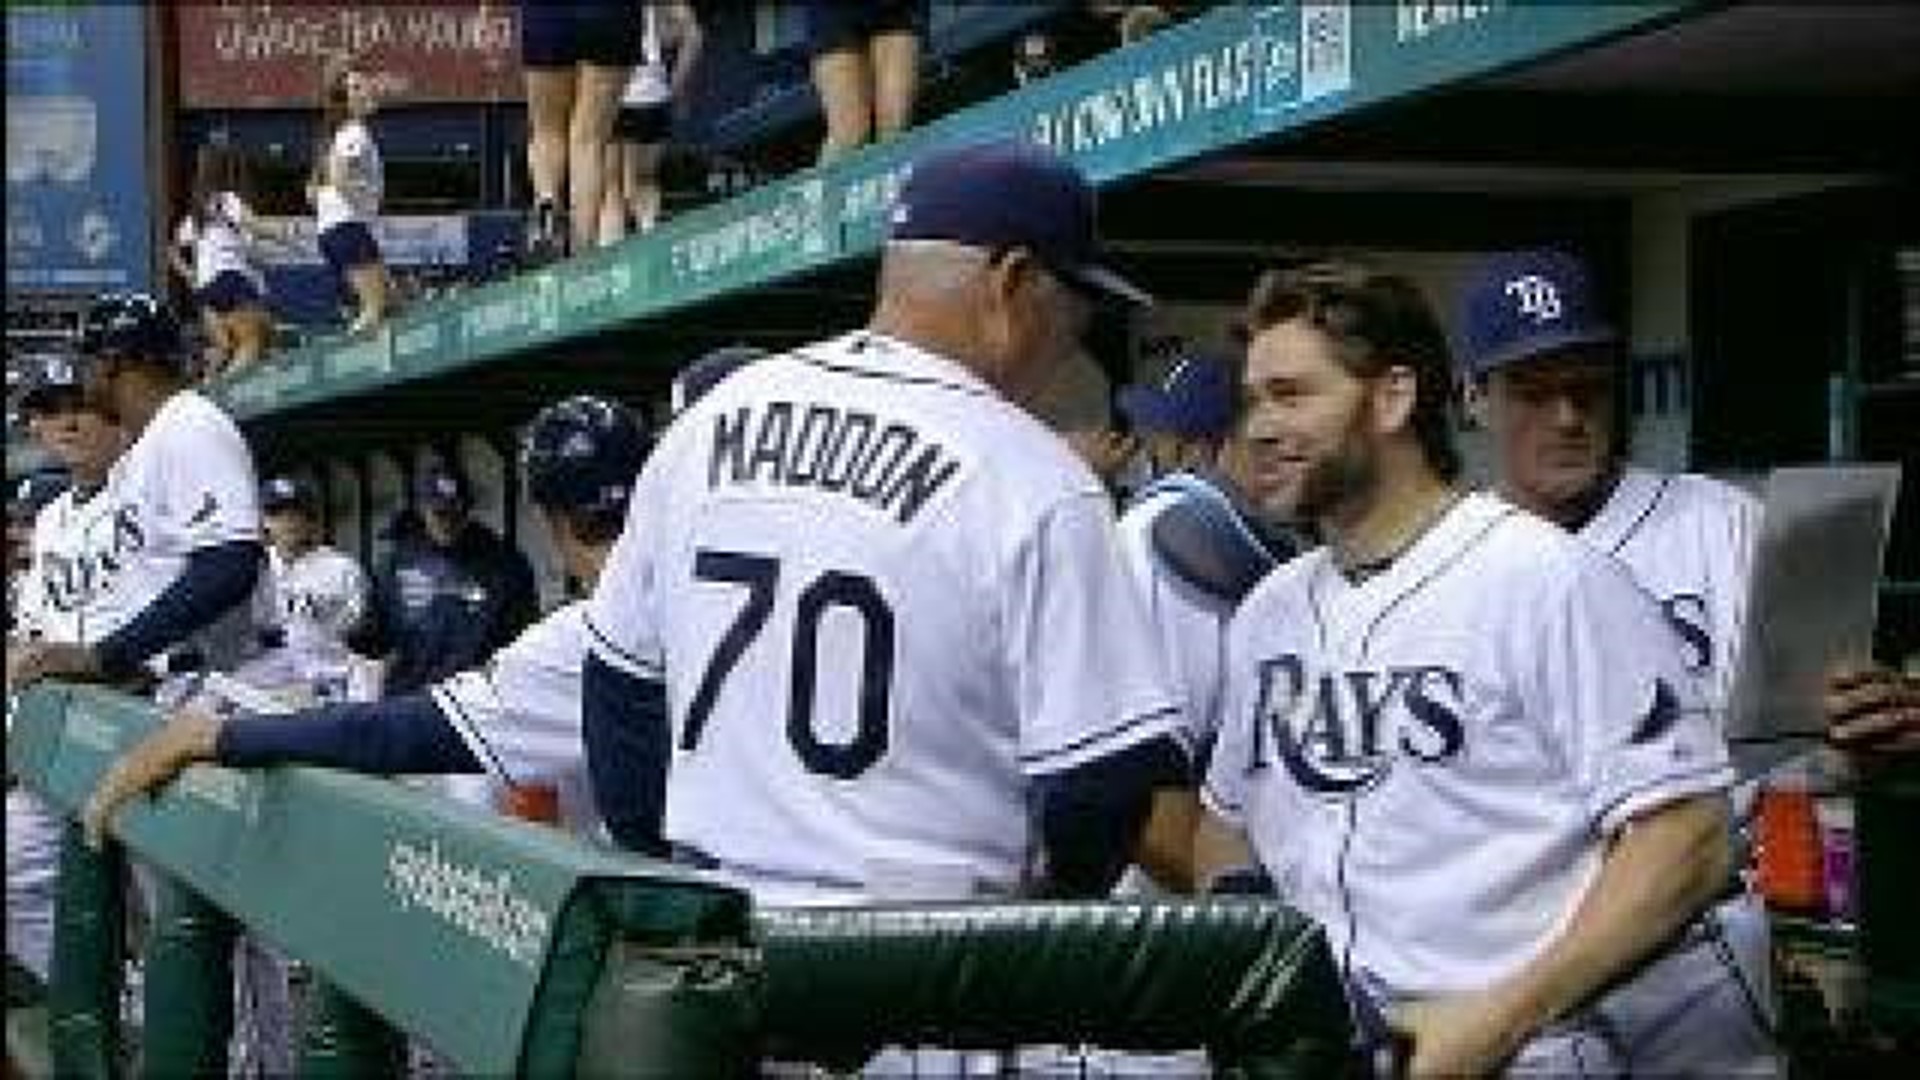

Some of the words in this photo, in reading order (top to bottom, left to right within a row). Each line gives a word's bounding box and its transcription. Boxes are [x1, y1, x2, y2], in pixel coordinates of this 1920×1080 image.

[707, 401, 961, 523] MADDON
[678, 549, 896, 780] 70
[1246, 653, 1466, 793] RAYS
